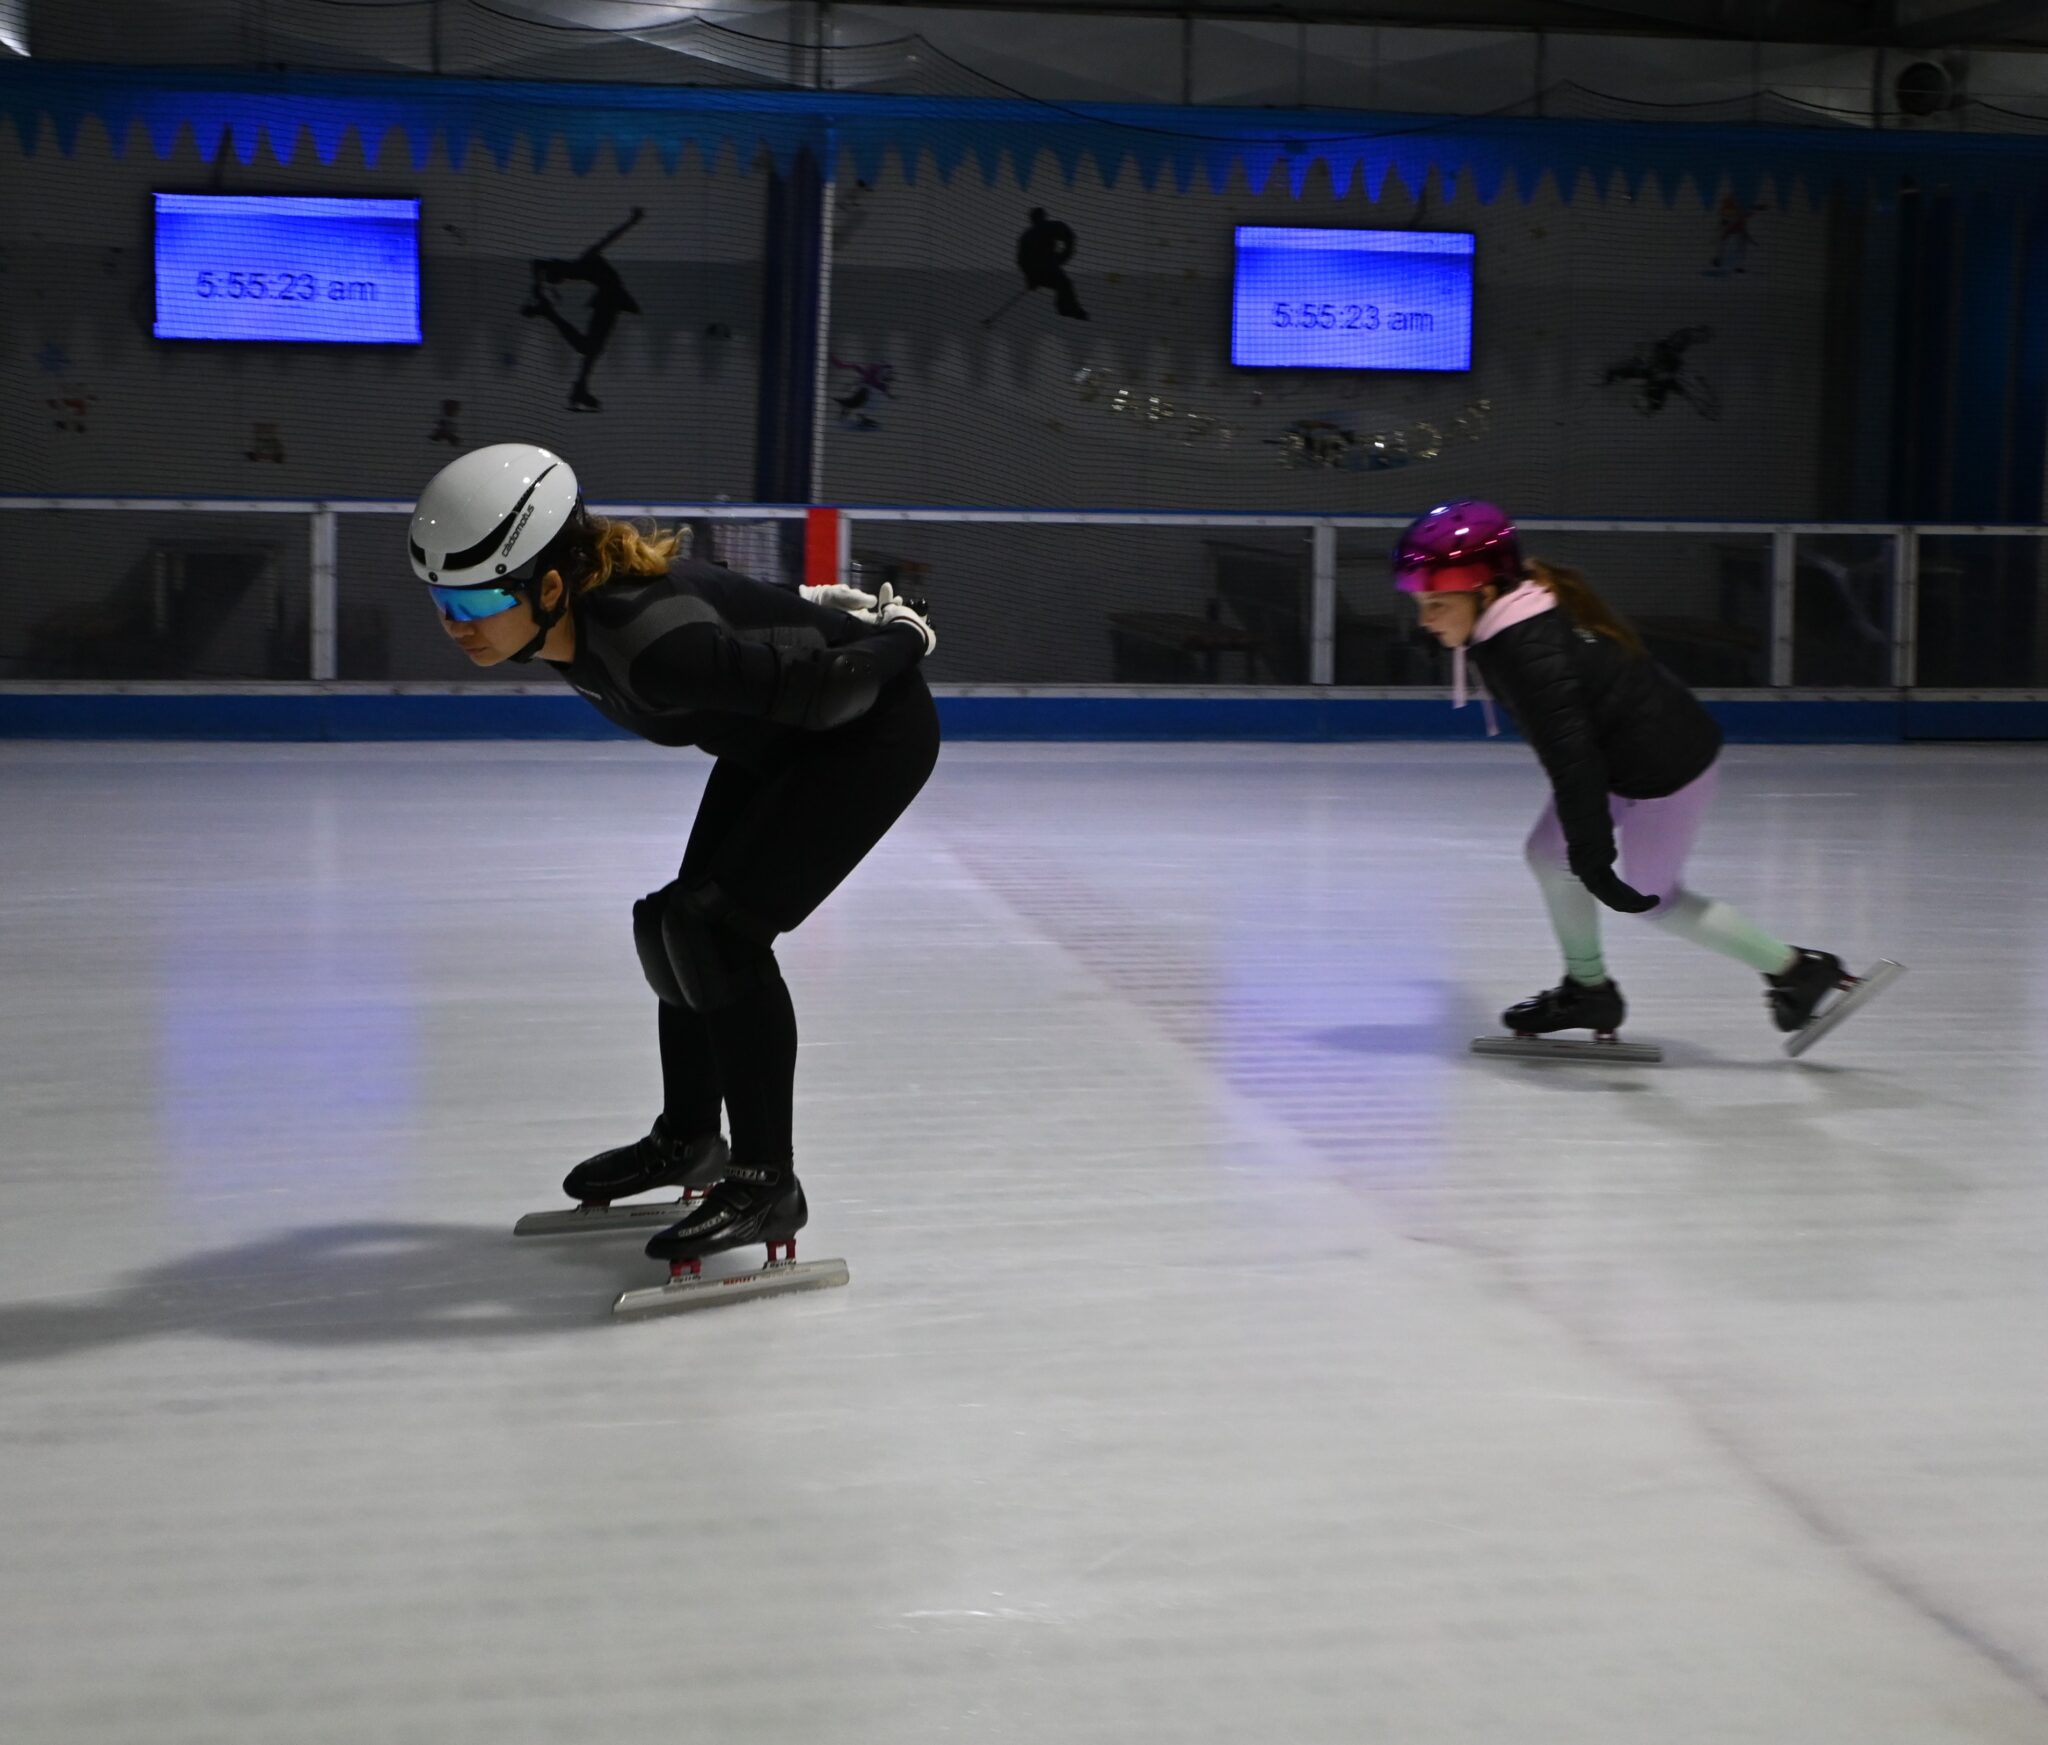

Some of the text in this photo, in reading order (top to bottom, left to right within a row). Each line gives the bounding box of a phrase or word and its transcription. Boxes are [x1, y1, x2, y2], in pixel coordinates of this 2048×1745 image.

[197, 271, 376, 300] 5:55:23 am
[1273, 302, 1434, 331] 5:55:23 am
